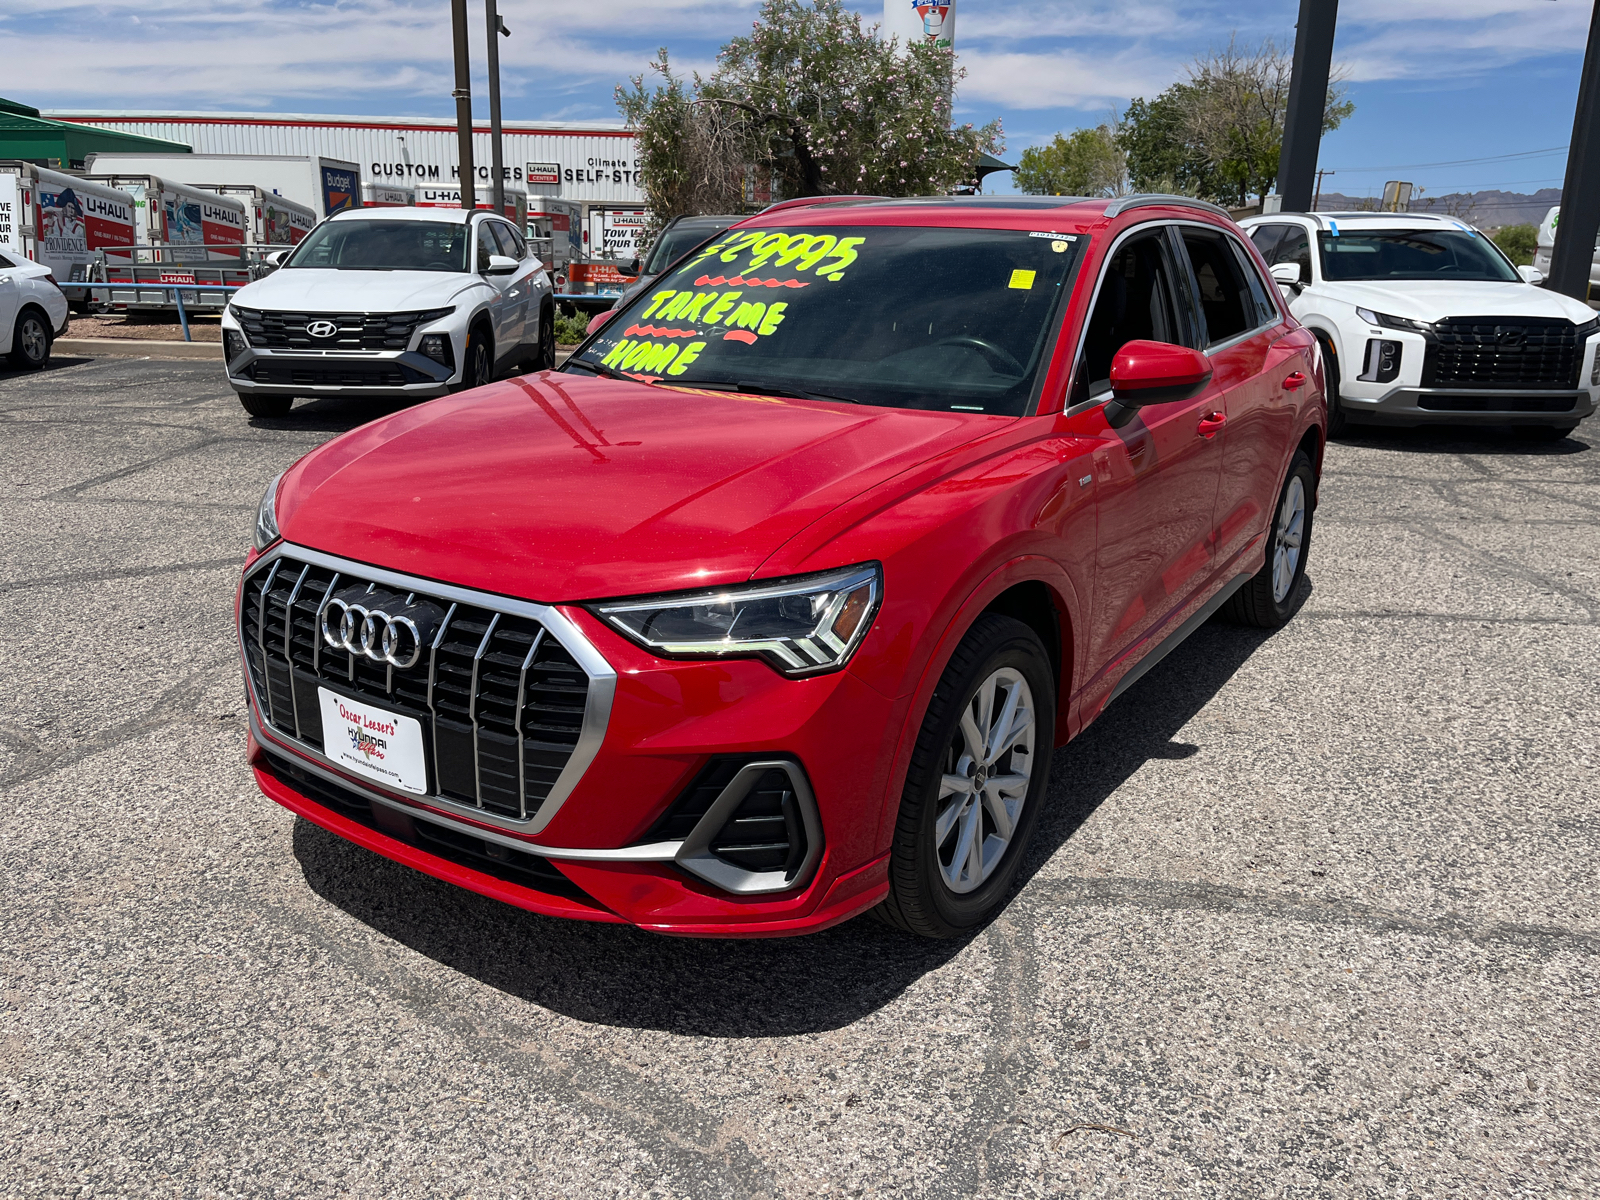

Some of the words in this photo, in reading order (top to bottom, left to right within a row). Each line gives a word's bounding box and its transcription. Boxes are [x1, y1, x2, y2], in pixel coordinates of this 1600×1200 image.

[371, 162, 439, 178] CUSTOM
[588, 158, 627, 168] Climate
[326, 172, 351, 192] Budget
[86, 197, 129, 220] U-HAUL
[204, 205, 240, 225] U-HAUL
[291, 212, 313, 230] U-HAUL
[604, 228, 628, 238] TOW
[45, 237, 84, 252] PROVIDENCE
[604, 239, 631, 248] YOUR
[160, 276, 195, 284] U-HAUL
[641, 289, 743, 325] TAKE
[724, 302, 789, 336] ME
[600, 339, 707, 376] HOME
[339, 703, 361, 725] Oscar
[363, 714, 395, 736] Leeser's
[347, 726, 388, 750] HYUNDAI
